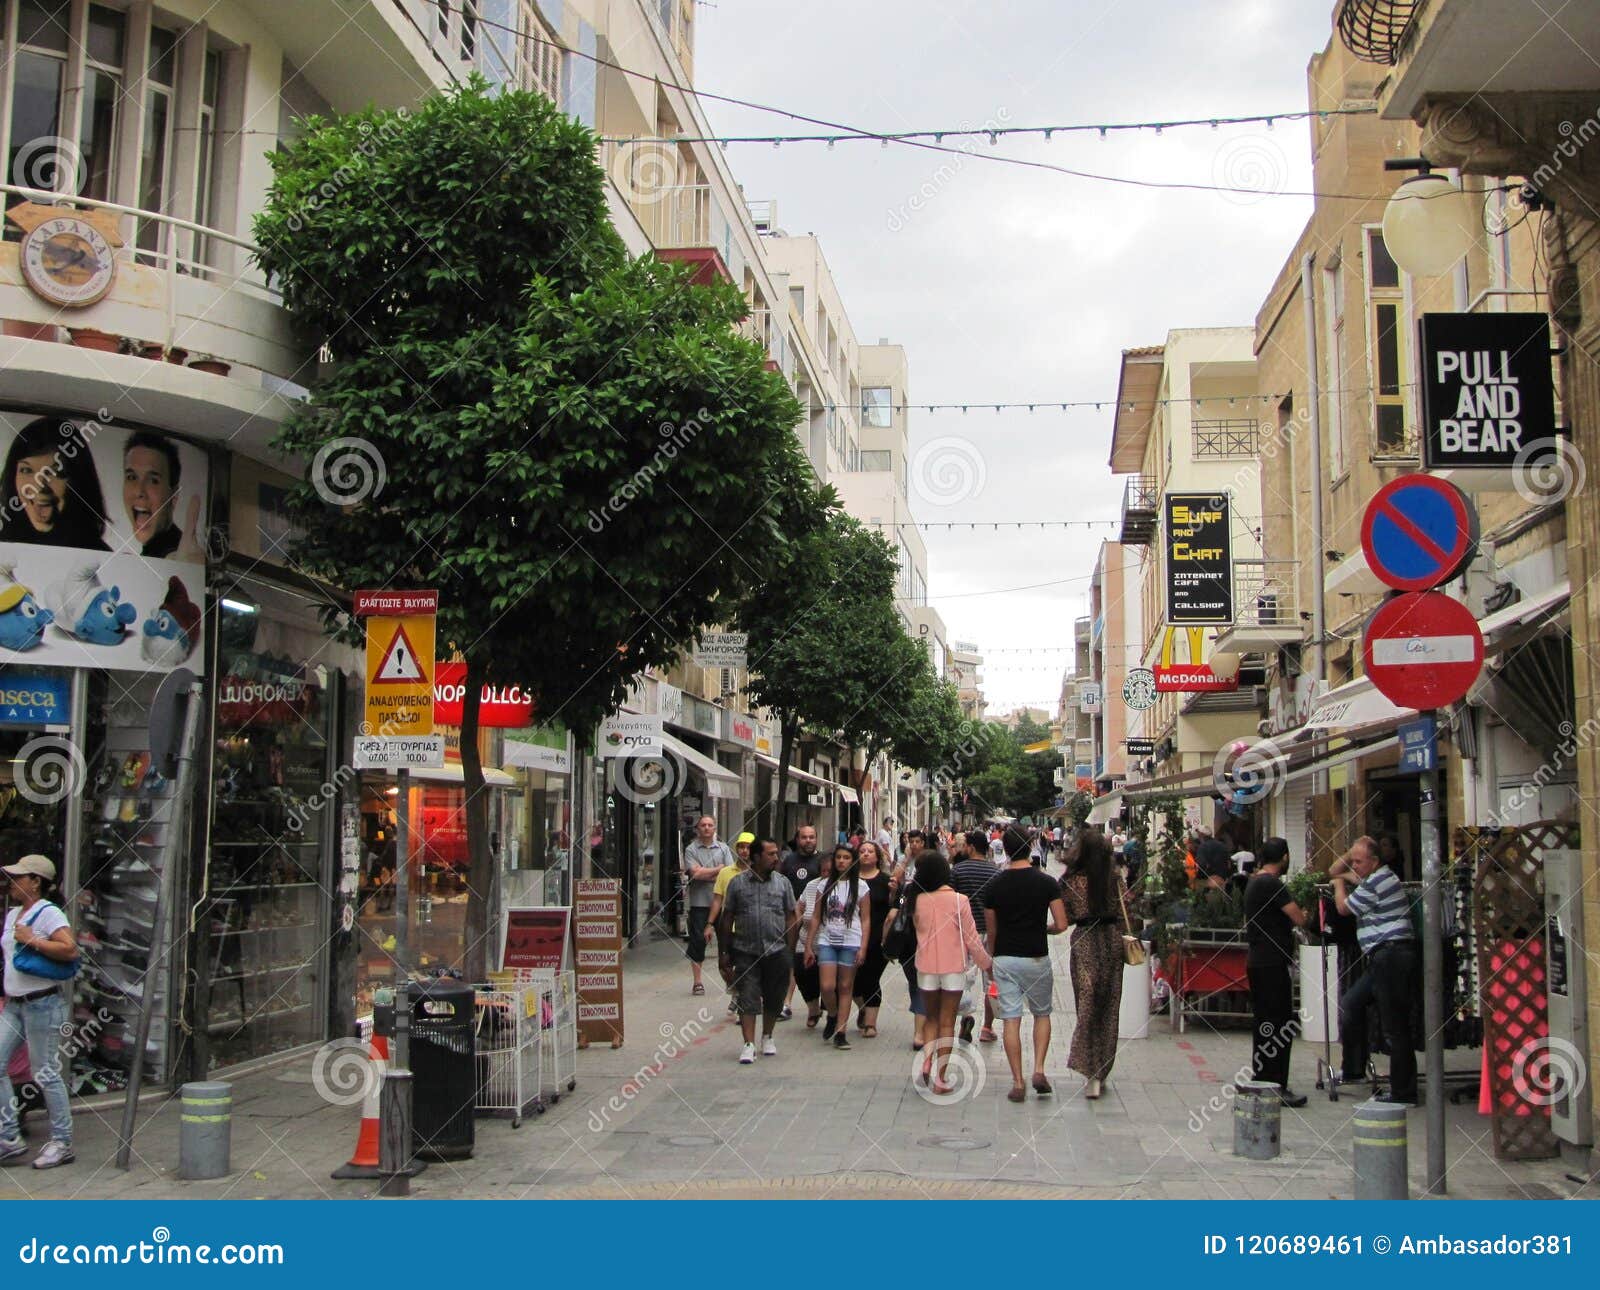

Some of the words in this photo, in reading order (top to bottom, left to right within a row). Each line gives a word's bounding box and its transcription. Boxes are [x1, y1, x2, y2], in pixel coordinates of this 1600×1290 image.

[29, 221, 106, 255] HABANA
[1437, 350, 1518, 384] PULL
[1456, 385, 1520, 418] AND
[1440, 420, 1522, 452] BEAR
[369, 696, 431, 707] ΑΝΑΔΥΟΜΕΝΟΙ
[624, 735, 651, 749] cyta
